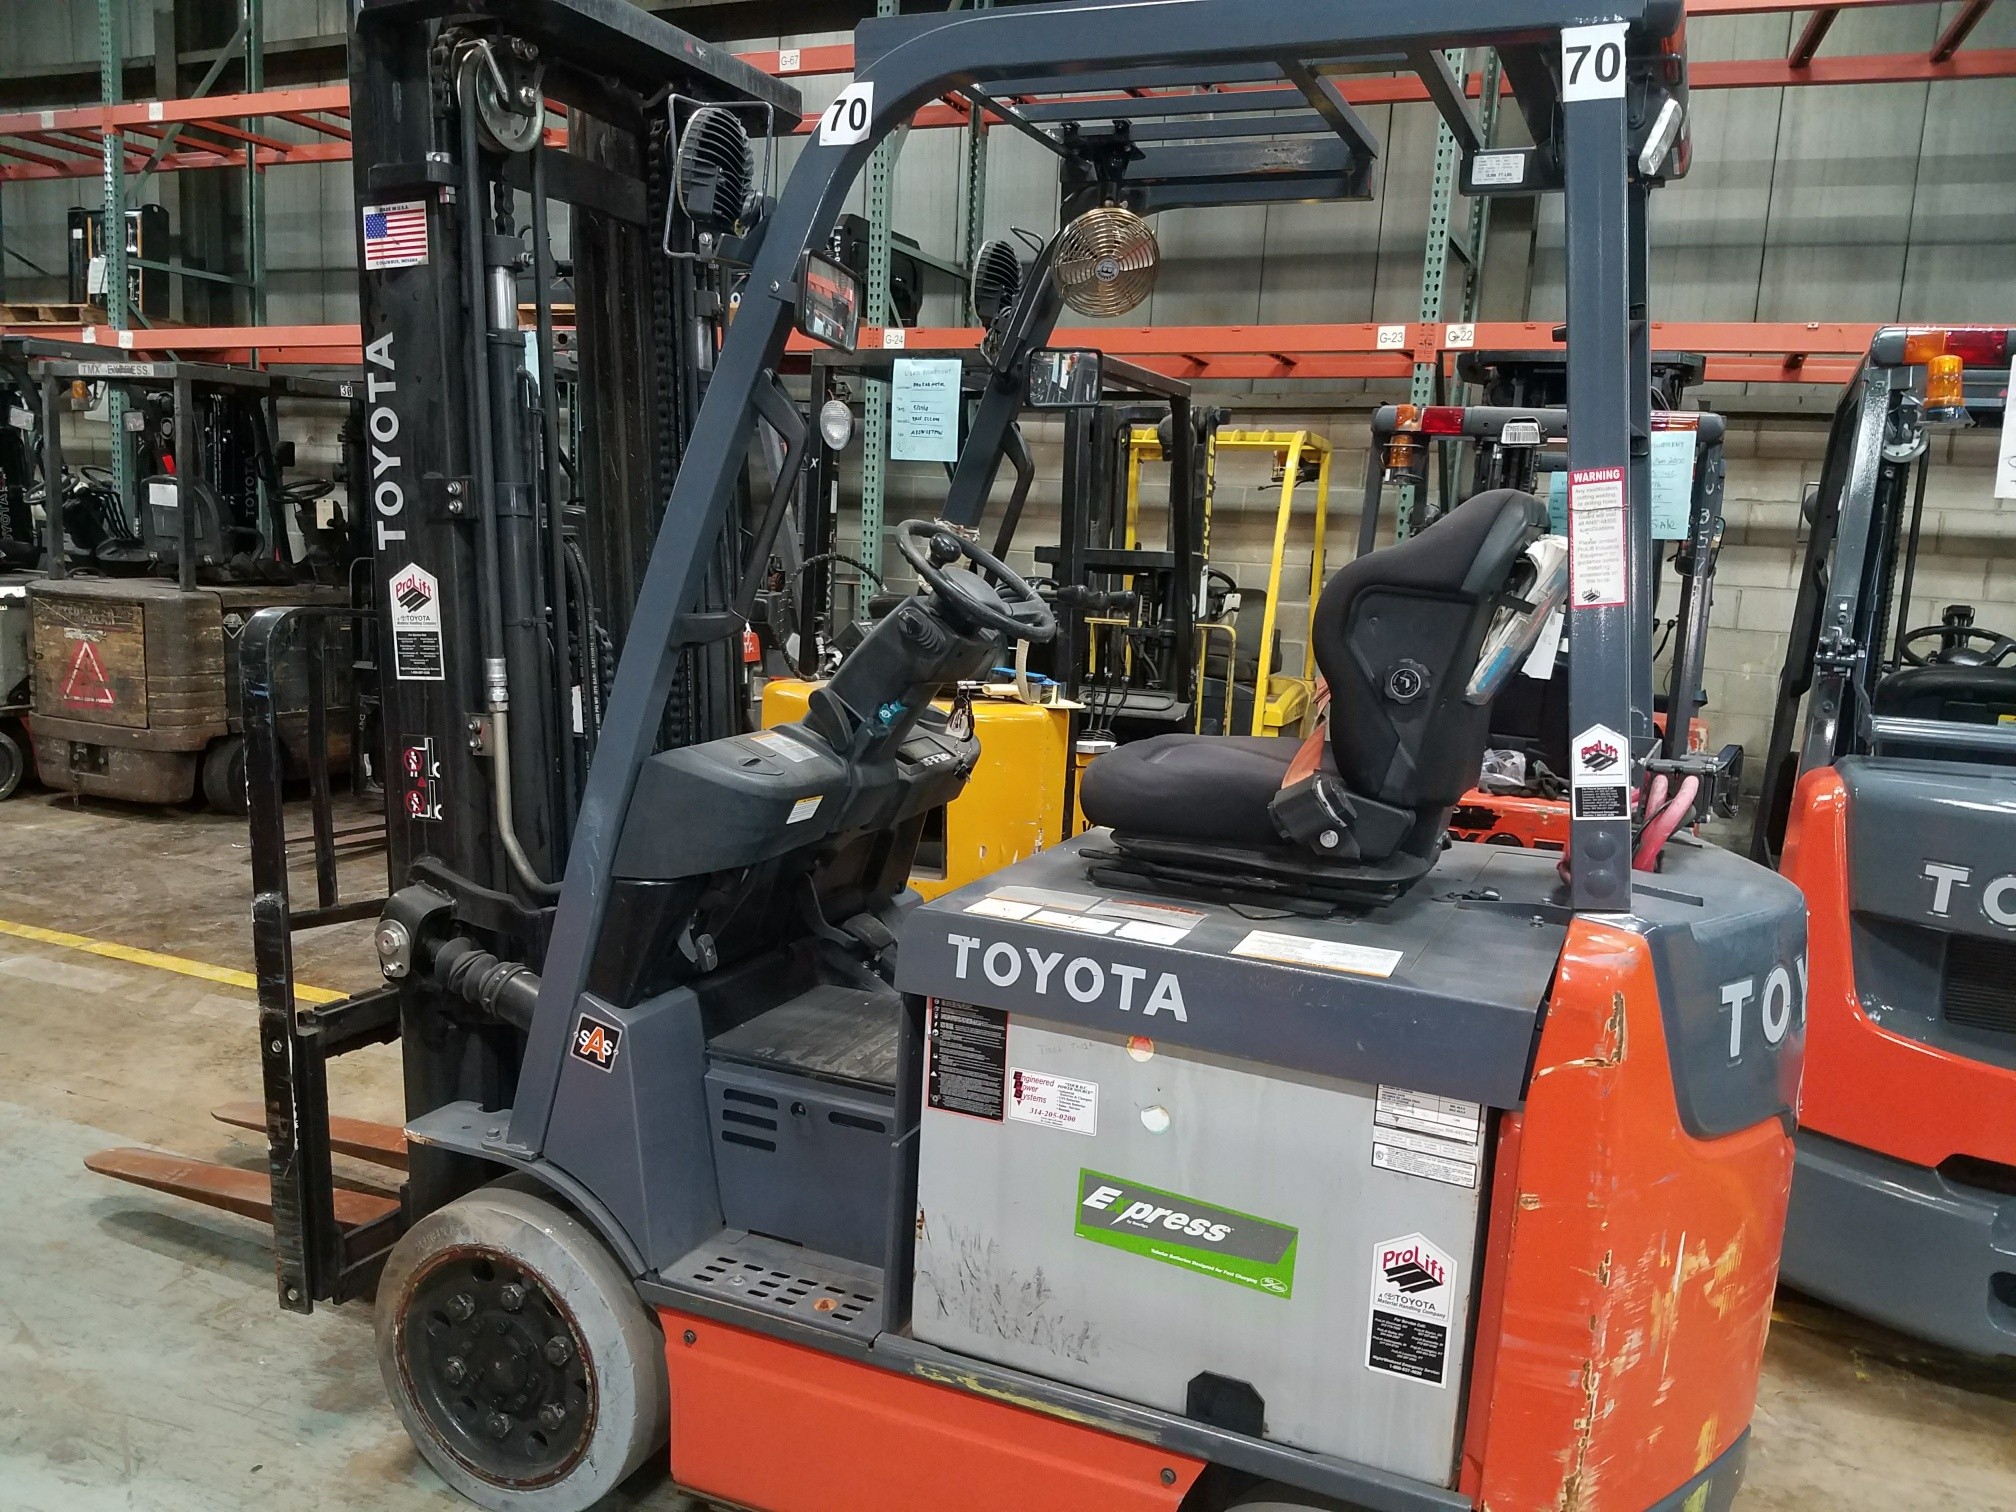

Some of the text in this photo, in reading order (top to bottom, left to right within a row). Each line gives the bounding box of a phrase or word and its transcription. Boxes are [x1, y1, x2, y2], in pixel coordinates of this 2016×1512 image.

[780, 54, 800, 68] G-67
[1565, 42, 1621, 85] 70
[829, 97, 867, 133] 70
[885, 330, 904, 346] G-24
[1379, 329, 1404, 347] G-23
[1447, 326, 1474, 345] G-22
[82, 364, 101, 375] TMX
[365, 331, 406, 551] TOYOTA
[1573, 468, 1621, 483] WARNING
[1203, 434, 1216, 560] HYSTER
[396, 573, 432, 598] ProLift
[1581, 739, 1619, 760] ProLift
[947, 933, 1188, 1023] TOYOTA
[1029, 1107, 1077, 1123] 314-205-0200
[1082, 1185, 1232, 1242] Express
[1169, 1253, 1192, 1265] Batteries
[1191, 1259, 1215, 1271] Designed
[1223, 1269, 1235, 1277] Fast
[1235, 1272, 1258, 1285] Charging
[1383, 1245, 1446, 1284] ProLift
[1377, 1297, 1446, 1318] Material Handling Company
[1395, 1294, 1436, 1311] TOYOTA
